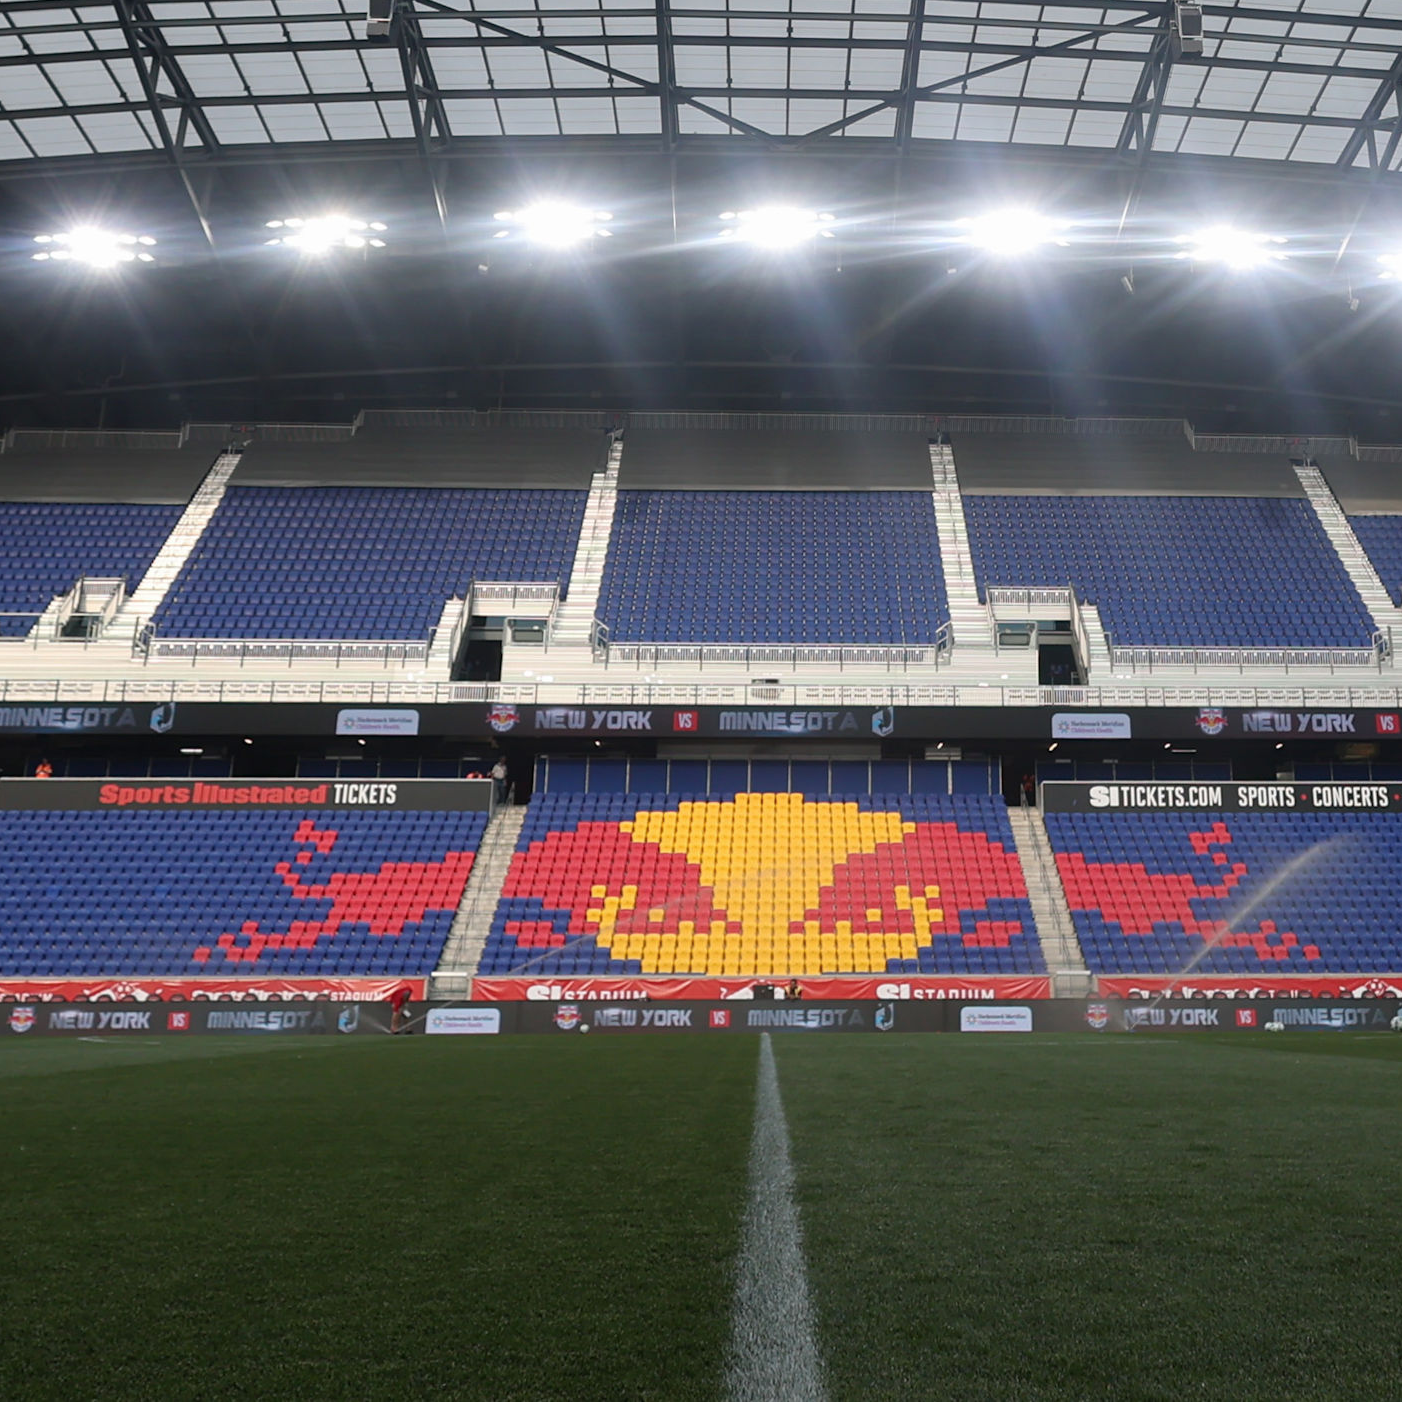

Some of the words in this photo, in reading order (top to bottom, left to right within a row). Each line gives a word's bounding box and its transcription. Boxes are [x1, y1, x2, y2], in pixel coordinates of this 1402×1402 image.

[534, 710, 585, 730] NEW
[590, 711, 653, 730] YORK
[677, 712, 693, 729] VS
[720, 711, 859, 732] MINNESOTA
[1242, 712, 1292, 732] NEW
[1297, 713, 1356, 732] YORK
[1379, 715, 1395, 731] VS
[100, 783, 190, 805] Sports
[192, 782, 328, 804] Illustrated
[333, 783, 397, 804] TICKETS
[1238, 785, 1295, 807] SPORTS
[1313, 786, 1389, 807] CONCERTS
[330, 991, 385, 1001] STADIUM
[564, 990, 648, 1000] STADIUM
[913, 989, 995, 1000] STADIUM
[49, 1010, 94, 1030] NEW
[98, 1011, 150, 1030] YORK
[172, 1013, 187, 1028] VS
[207, 1011, 324, 1031] MINNESOTA
[594, 1008, 639, 1027] NEW
[641, 1009, 693, 1028] YORK
[711, 1010, 727, 1026] VS
[748, 1009, 865, 1028] MINNESOTA
[1123, 1007, 1165, 1026] NEW
[1169, 1008, 1219, 1026] YORK
[1238, 1010, 1253, 1025] VS
[1273, 1008, 1388, 1027] MINNESOTA
